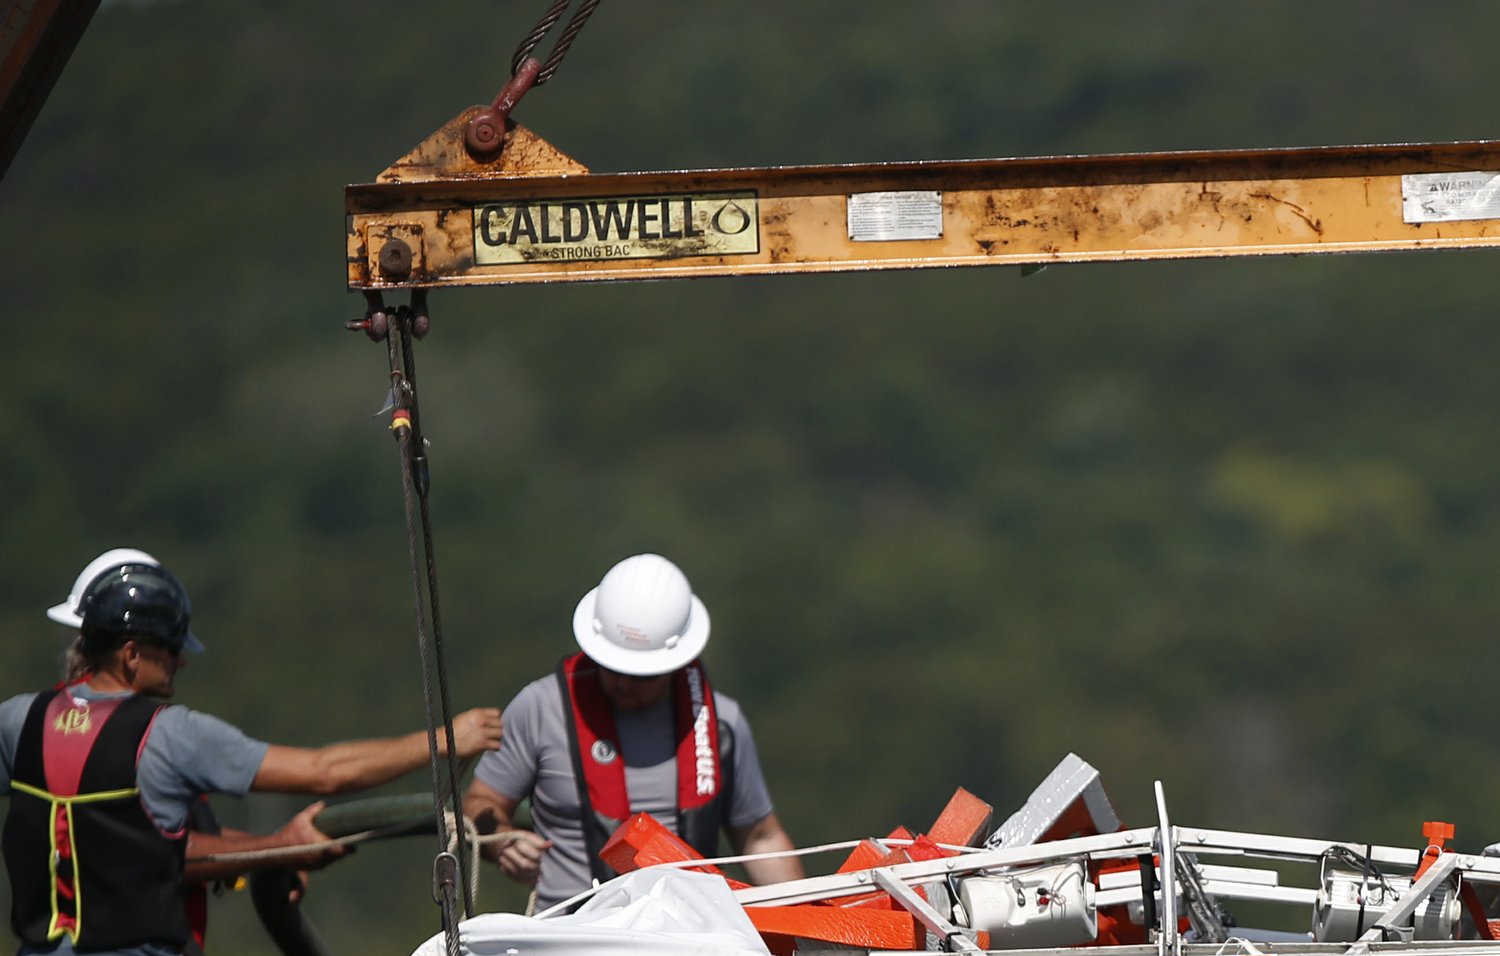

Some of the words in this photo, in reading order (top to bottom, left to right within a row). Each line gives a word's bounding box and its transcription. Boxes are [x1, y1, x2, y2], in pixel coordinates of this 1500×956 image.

[1440, 179, 1492, 191] WARNIN
[479, 197, 705, 247] CALDWELL
[551, 245, 600, 259] STRONG
